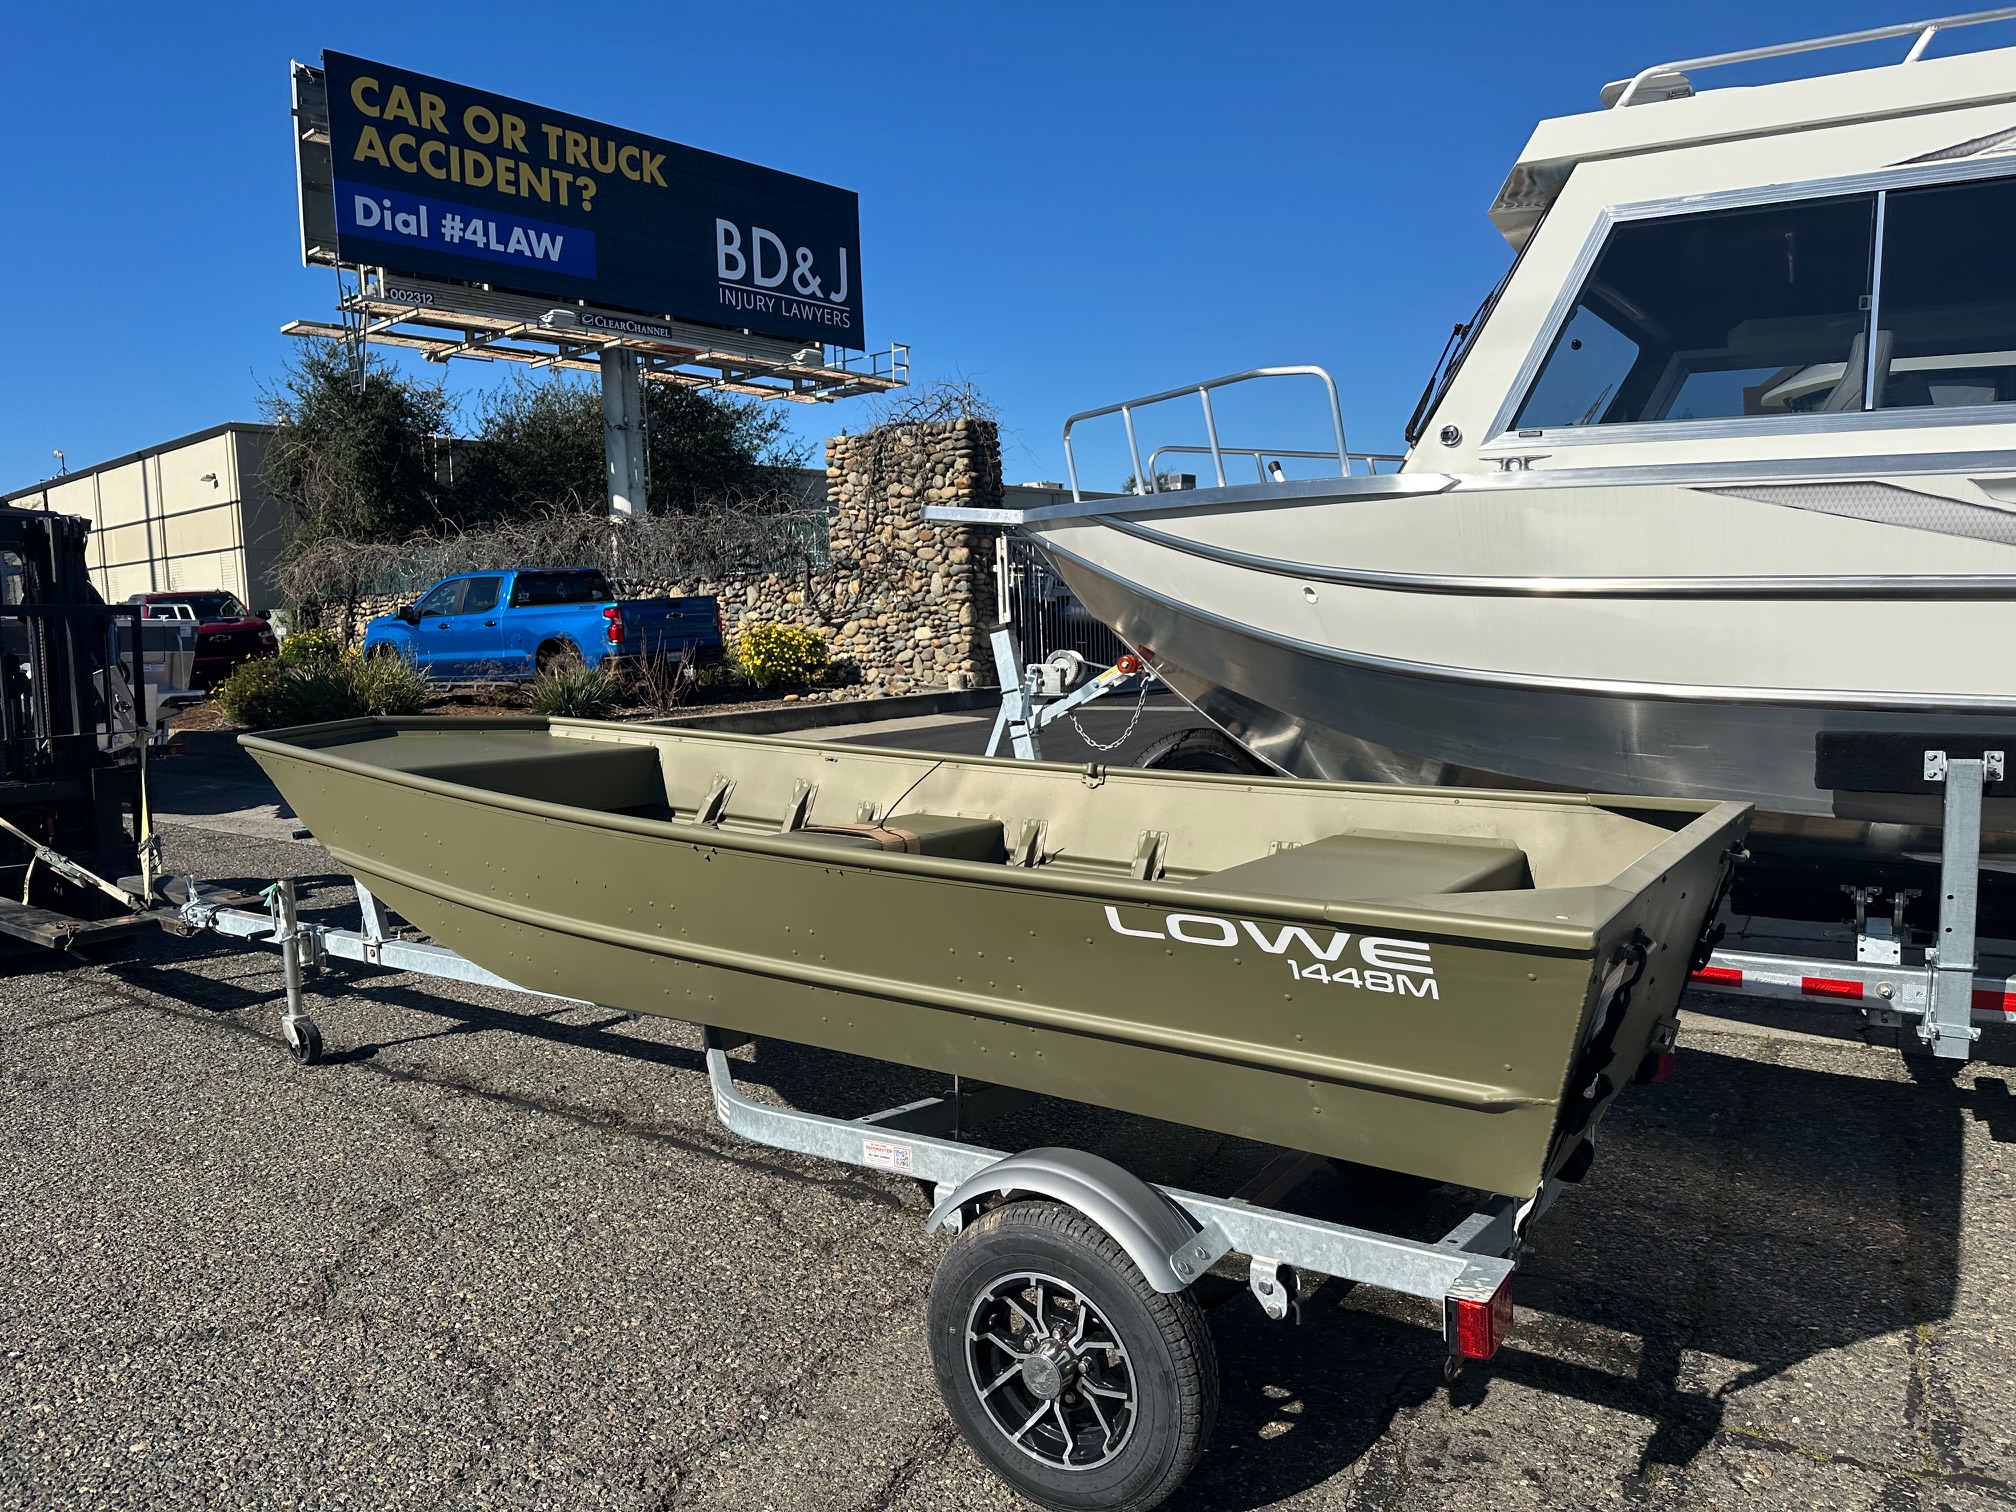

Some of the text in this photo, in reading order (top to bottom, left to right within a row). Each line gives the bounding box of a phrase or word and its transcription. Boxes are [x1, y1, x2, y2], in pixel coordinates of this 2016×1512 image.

[350, 76, 668, 188] CAR OR TRUCK
[353, 125, 597, 211] ACCIDENT?
[354, 194, 564, 262] Dial #4LAW
[715, 218, 849, 303] BD&J
[390, 288, 434, 305] 002312
[719, 287, 851, 329] INJURY LAWYERS
[1103, 905, 1435, 976] LOWE
[1286, 958, 1440, 1001] 1448M
